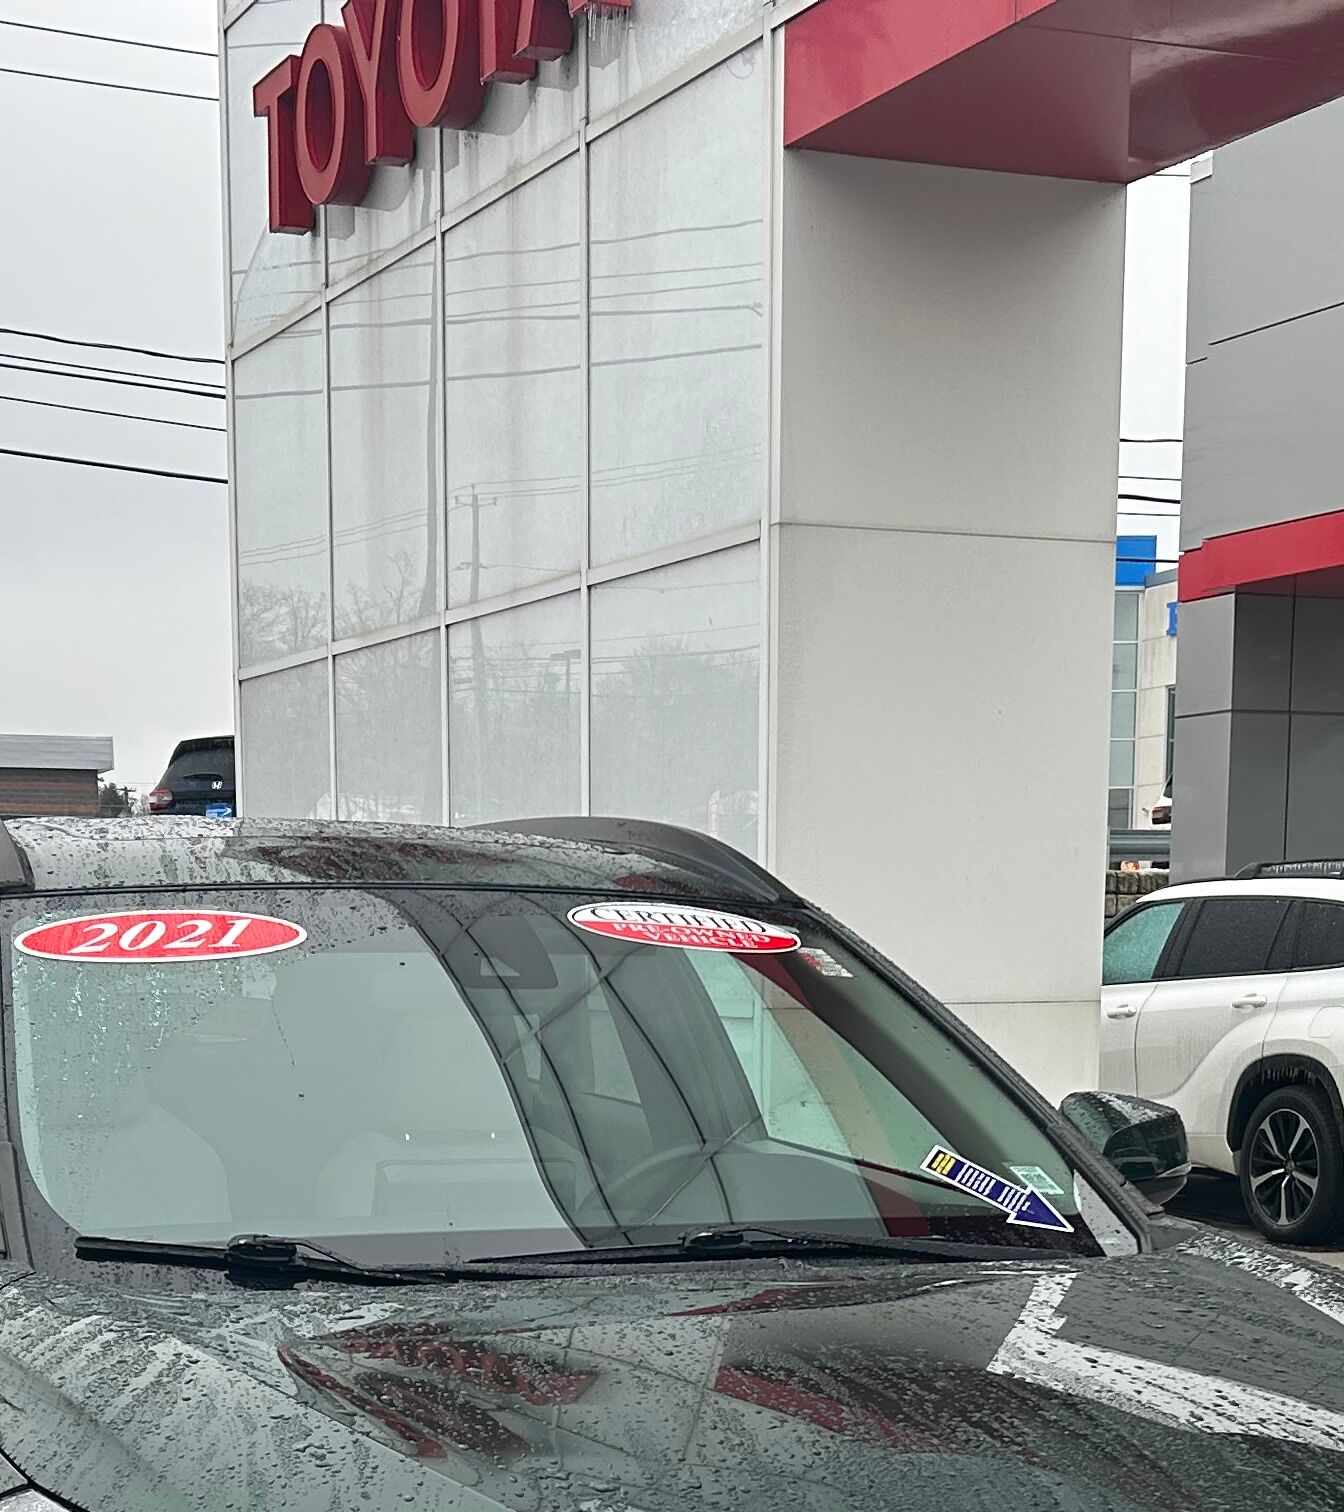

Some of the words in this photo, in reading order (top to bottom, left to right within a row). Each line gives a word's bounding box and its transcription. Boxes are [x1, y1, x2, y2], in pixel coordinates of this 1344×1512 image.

[253, 0, 632, 235] TOYO
[67, 918, 254, 954] 2021
[590, 908, 767, 933] CERTIFIED
